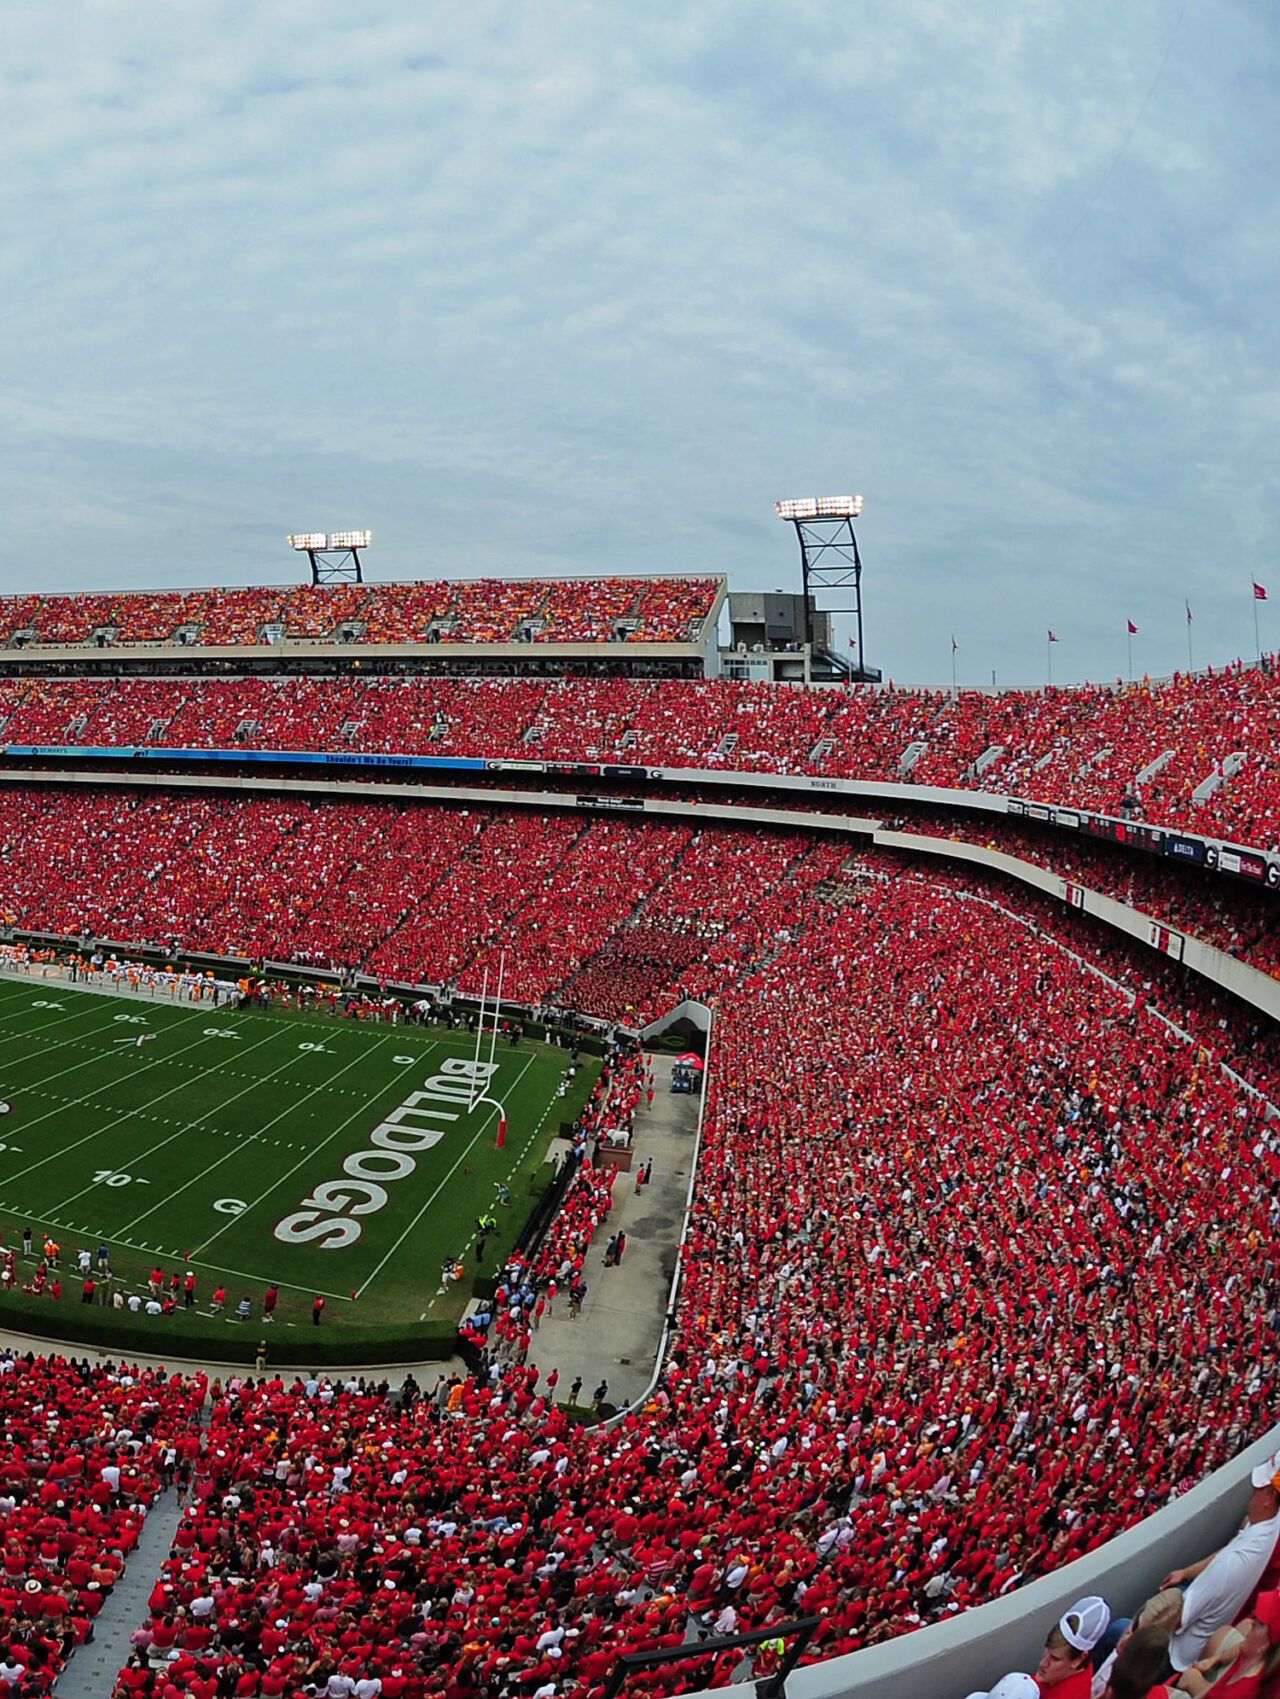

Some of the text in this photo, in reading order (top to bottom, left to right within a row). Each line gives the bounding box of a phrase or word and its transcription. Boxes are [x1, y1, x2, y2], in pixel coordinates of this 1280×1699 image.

[1178, 843, 1194, 856] DELTA
[274, 1057, 500, 1249] BULLDOGS
[92, 1170, 132, 1187] 10
[213, 1198, 248, 1215] G
